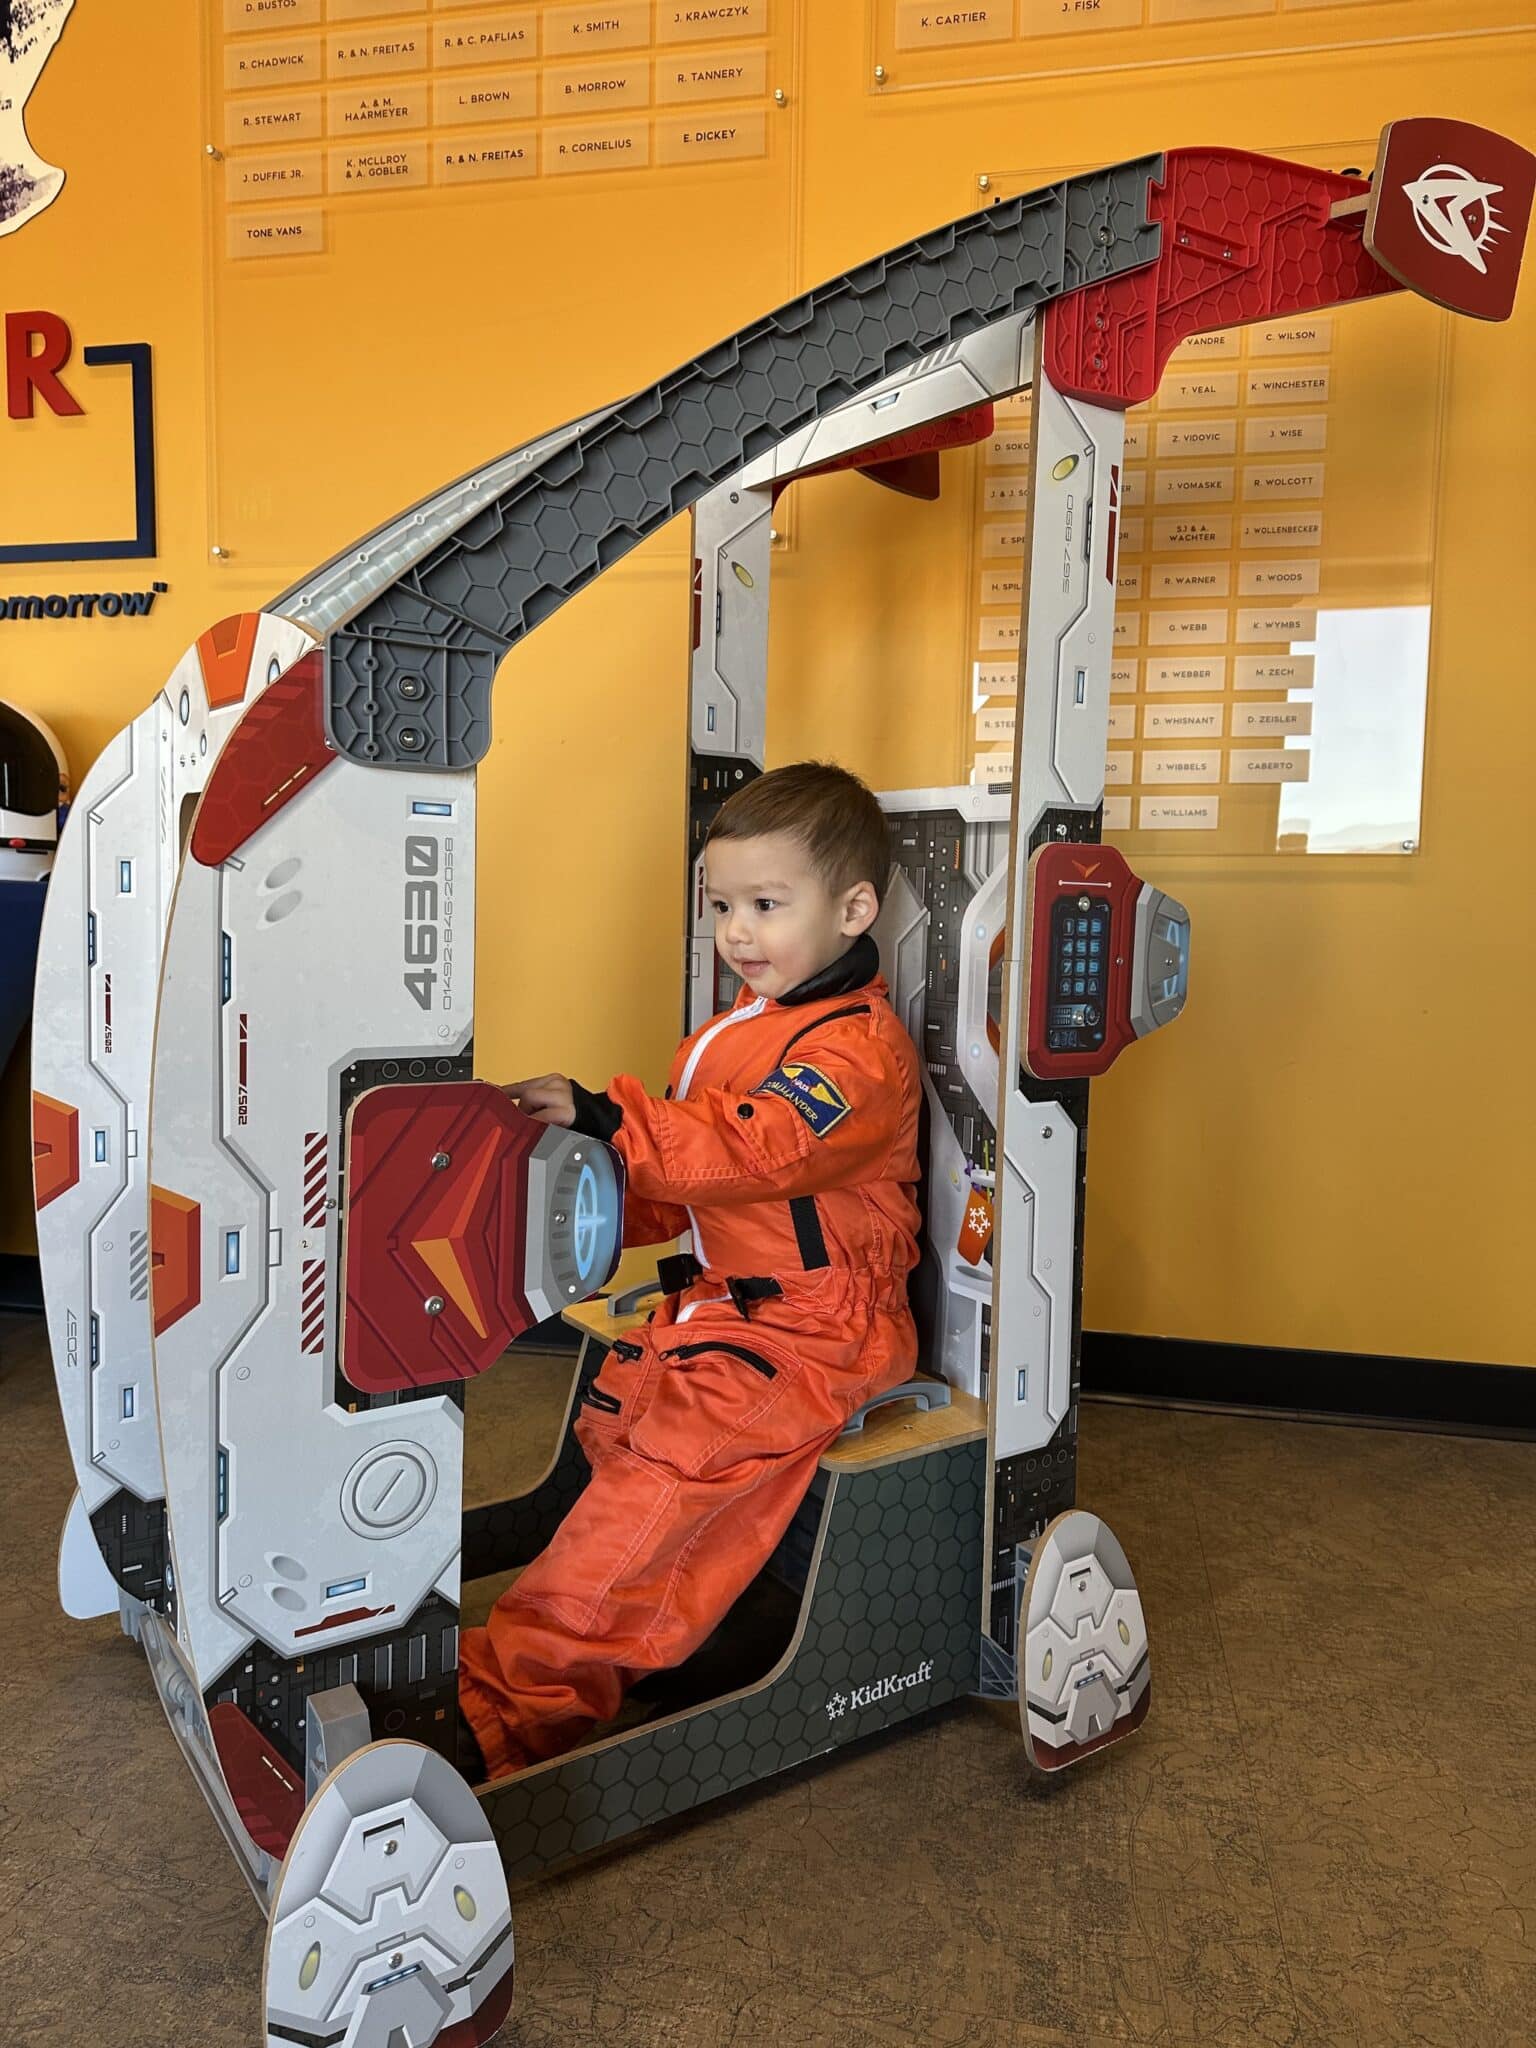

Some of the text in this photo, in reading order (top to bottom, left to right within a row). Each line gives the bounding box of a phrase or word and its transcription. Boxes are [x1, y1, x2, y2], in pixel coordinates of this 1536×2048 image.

[257, 0, 297, 11] BUSTOS
[1074, 0, 1101, 12] FISK
[686, 6, 749, 22] KRAWCZYK
[936, 11, 987, 25] CARTIER
[586, 20, 620, 32] SMITH
[480, 30, 525, 44] PAFLIAS
[373, 42, 415, 56] FREITAS
[251, 54, 304, 69] CHADWICK
[691, 67, 743, 81] TANNERY
[578, 79, 627, 93] MORROW
[471, 90, 510, 104] BROWN
[255, 112, 301, 125] STEWART
[345, 107, 408, 121] HAARMEYER
[695, 128, 736, 142] DICKEY
[571, 138, 632, 153] CORNELIUS
[359, 153, 407, 167] MCLLROY
[481, 149, 524, 161] FREITAS
[252, 171, 286, 182] DUFFIE
[290, 169, 304, 179] JR.
[369, 165, 409, 177] GOBLER
[247, 225, 302, 239] TONE VANS
[1187, 336, 1225, 346] VANDRE
[1278, 331, 1316, 341] WILSON
[5, 310, 86, 419] R
[1192, 385, 1216, 394] VEAL
[1263, 379, 1326, 390] WINCHESTER
[1183, 433, 1221, 442] VIDOVIC
[1280, 429, 1303, 438] WISE
[1177, 481, 1222, 490] VOMASKE
[1265, 476, 1313, 487] WOLCOTT
[1254, 524, 1319, 535] WOLLENBECKER
[1169, 533, 1216, 542] WACHTER
[1176, 575, 1217, 585] WARNER
[1267, 572, 1303, 582] WOODS
[1181, 623, 1207, 632] WEBB
[1265, 620, 1301, 629] WYMBS
[1172, 670, 1211, 679] WEBBER
[1269, 668, 1294, 677] ZECH
[1165, 716, 1215, 725] WHISNANT
[1259, 715, 1297, 724] ZEISLER
[1166, 763, 1207, 771] WIBBELS
[1247, 762, 1294, 770] CABERTO
[1162, 809, 1209, 817] WILLIAMS
[238, 1086, 248, 1126] 2057
[66, 1307, 78, 1368] 2057
[850, 1660, 932, 1710] KidKraft
